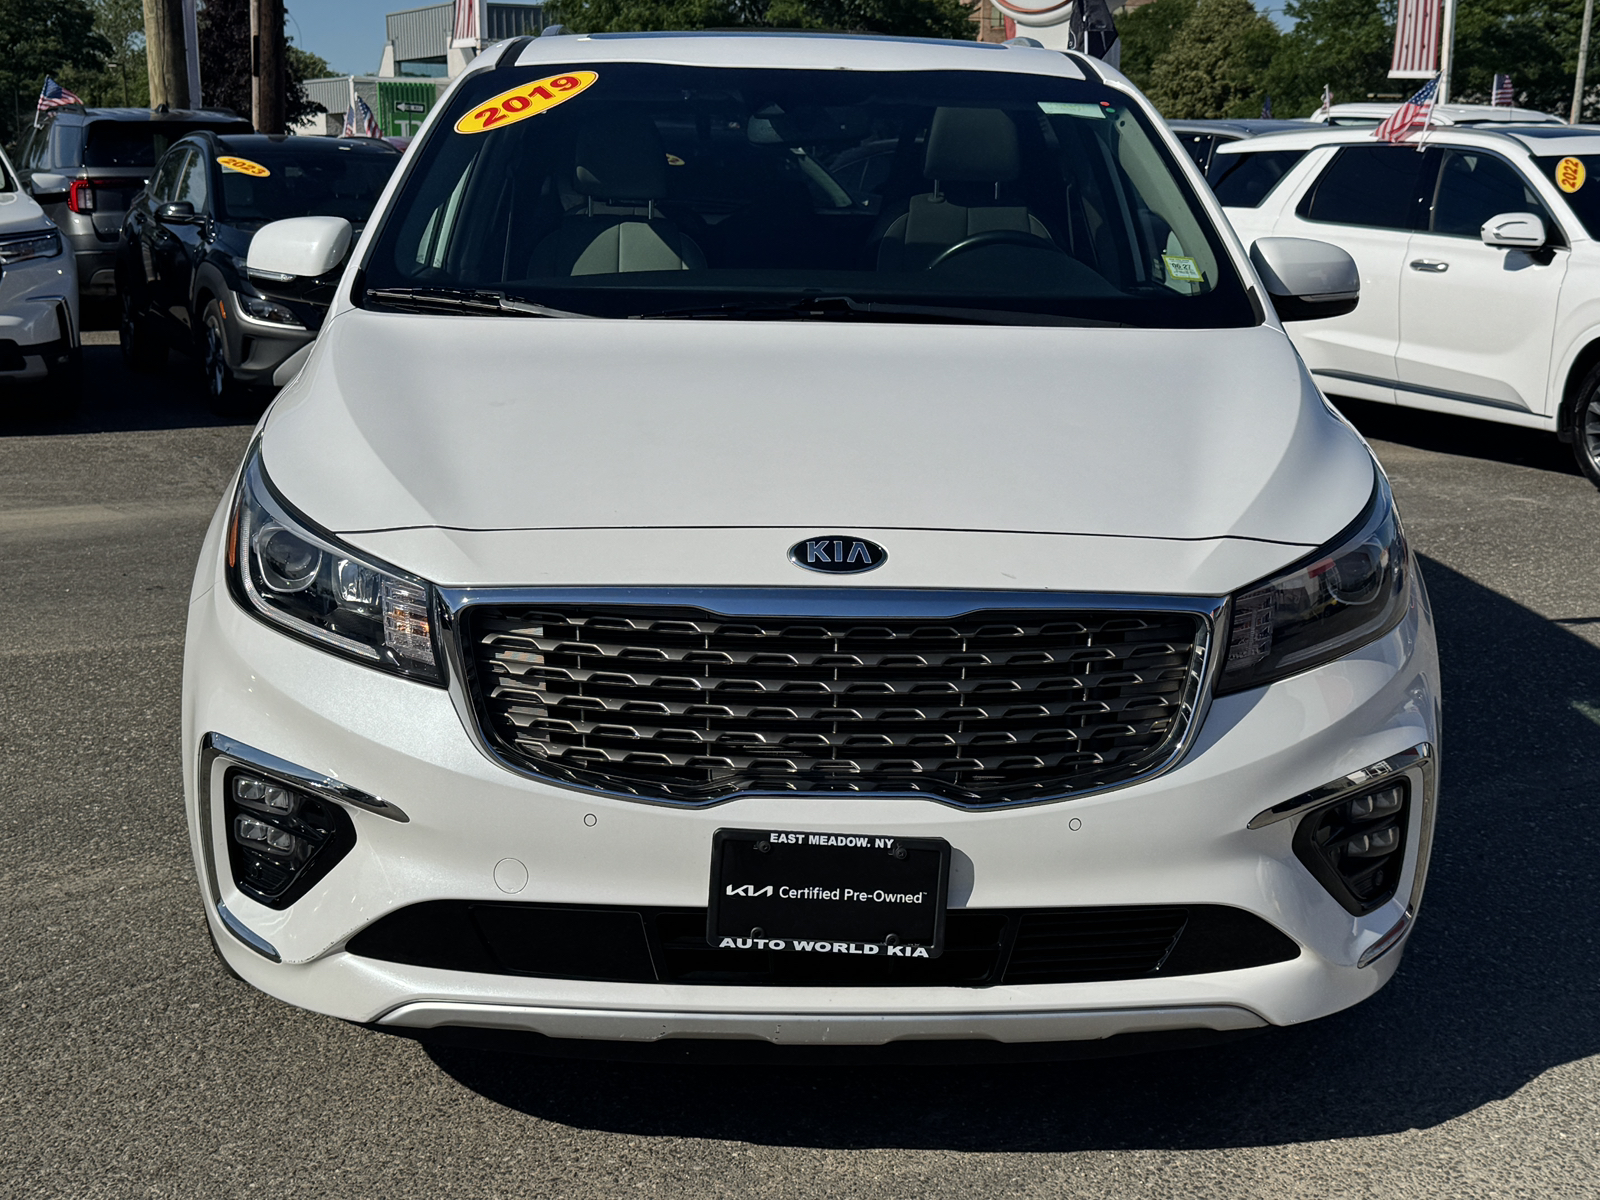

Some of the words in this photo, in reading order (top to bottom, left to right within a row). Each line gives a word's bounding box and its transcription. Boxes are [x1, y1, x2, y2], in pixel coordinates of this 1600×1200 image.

[474, 76, 582, 128] 2019
[219, 158, 267, 175] 2023
[1561, 159, 1579, 188] 2022
[806, 541, 872, 563] KIA
[770, 833, 804, 844] EAST
[874, 838, 894, 849] NY
[779, 886, 840, 900] Certified
[719, 938, 785, 950] AUTO
[793, 940, 879, 954] WORLD
[887, 945, 929, 957] KIA
